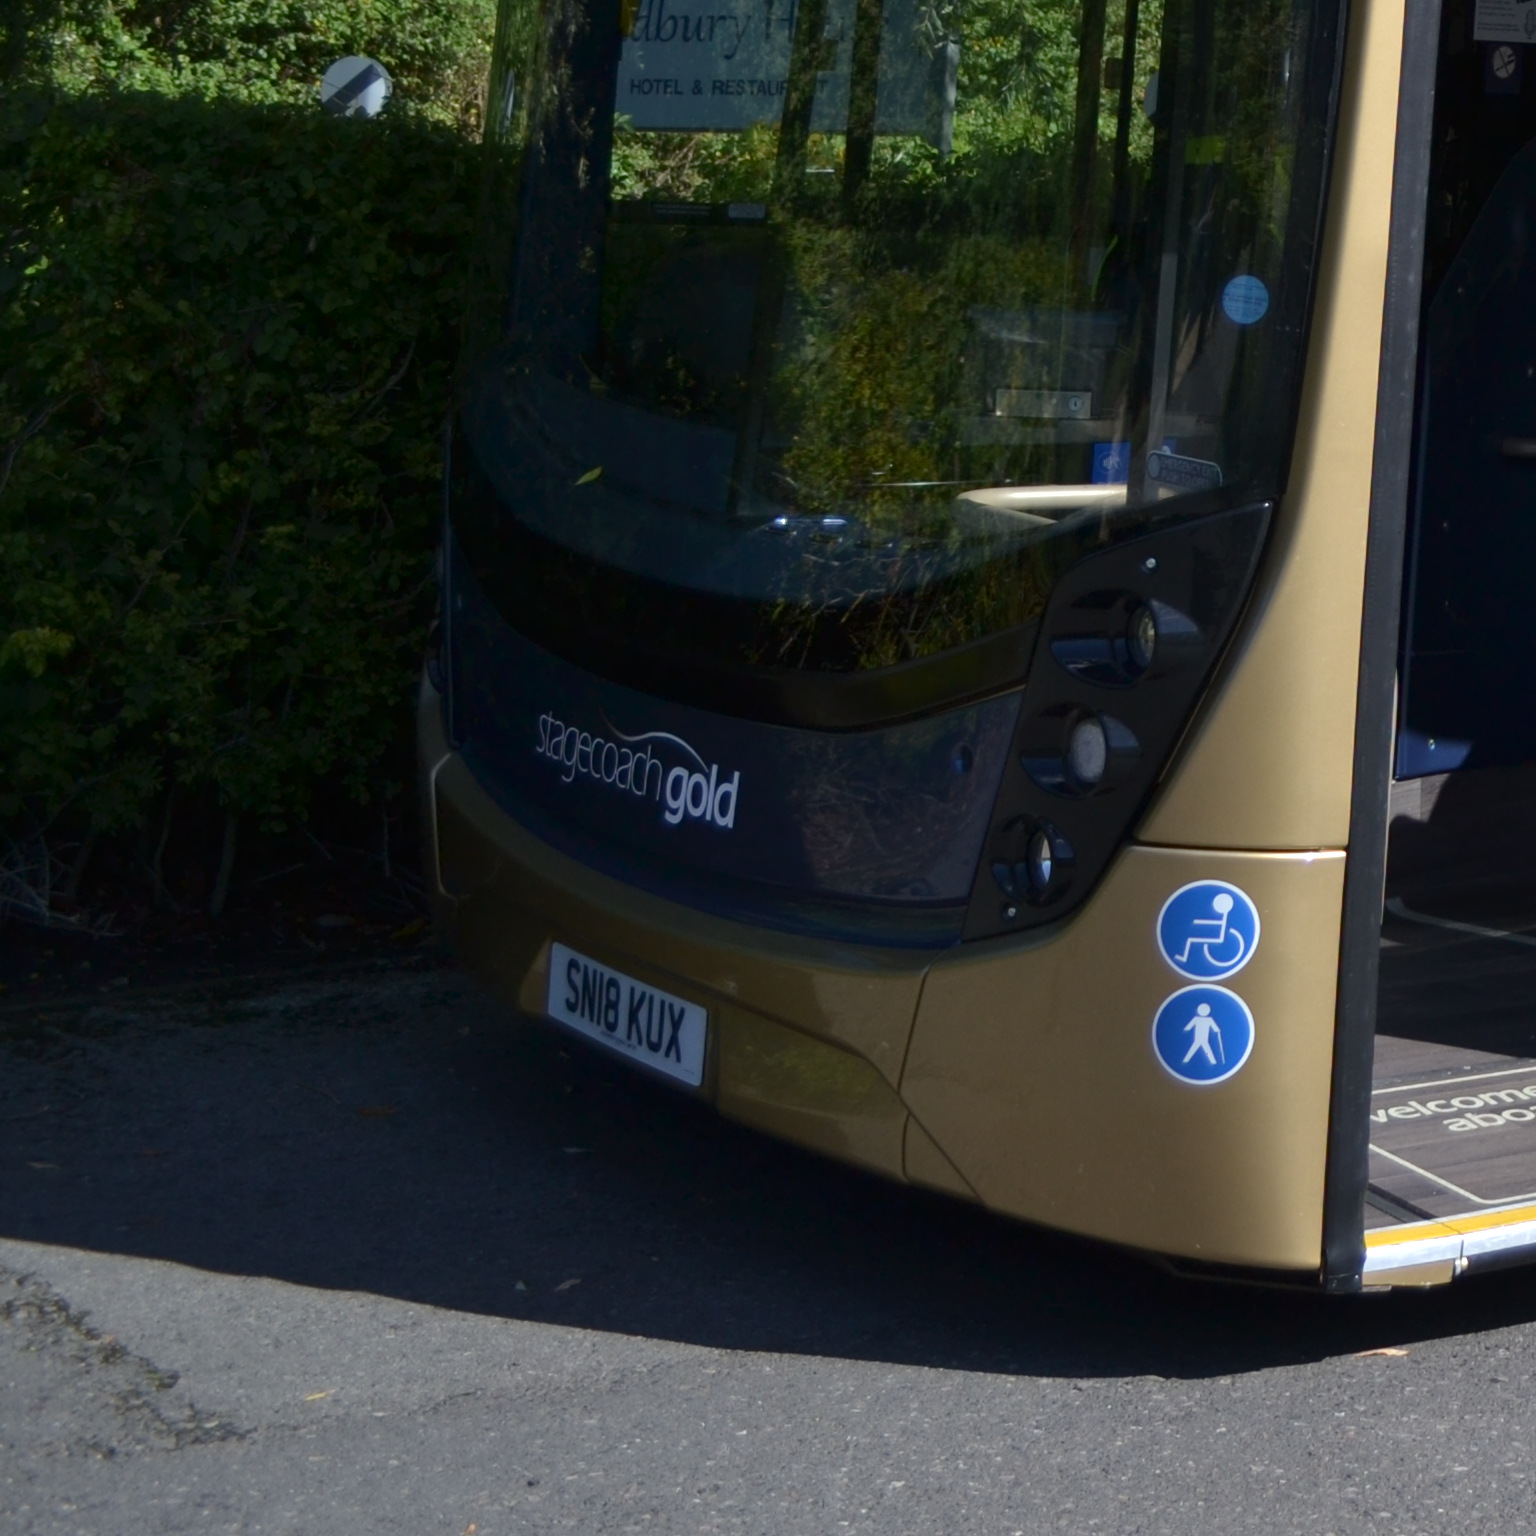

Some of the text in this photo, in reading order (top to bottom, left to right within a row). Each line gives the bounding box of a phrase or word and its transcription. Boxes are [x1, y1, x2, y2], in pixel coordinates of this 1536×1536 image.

[630, 78, 829, 96] HOTEL & RESTAUT
[536, 710, 741, 829] stagecoach gold
[565, 957, 686, 1064] SN18 KUX
